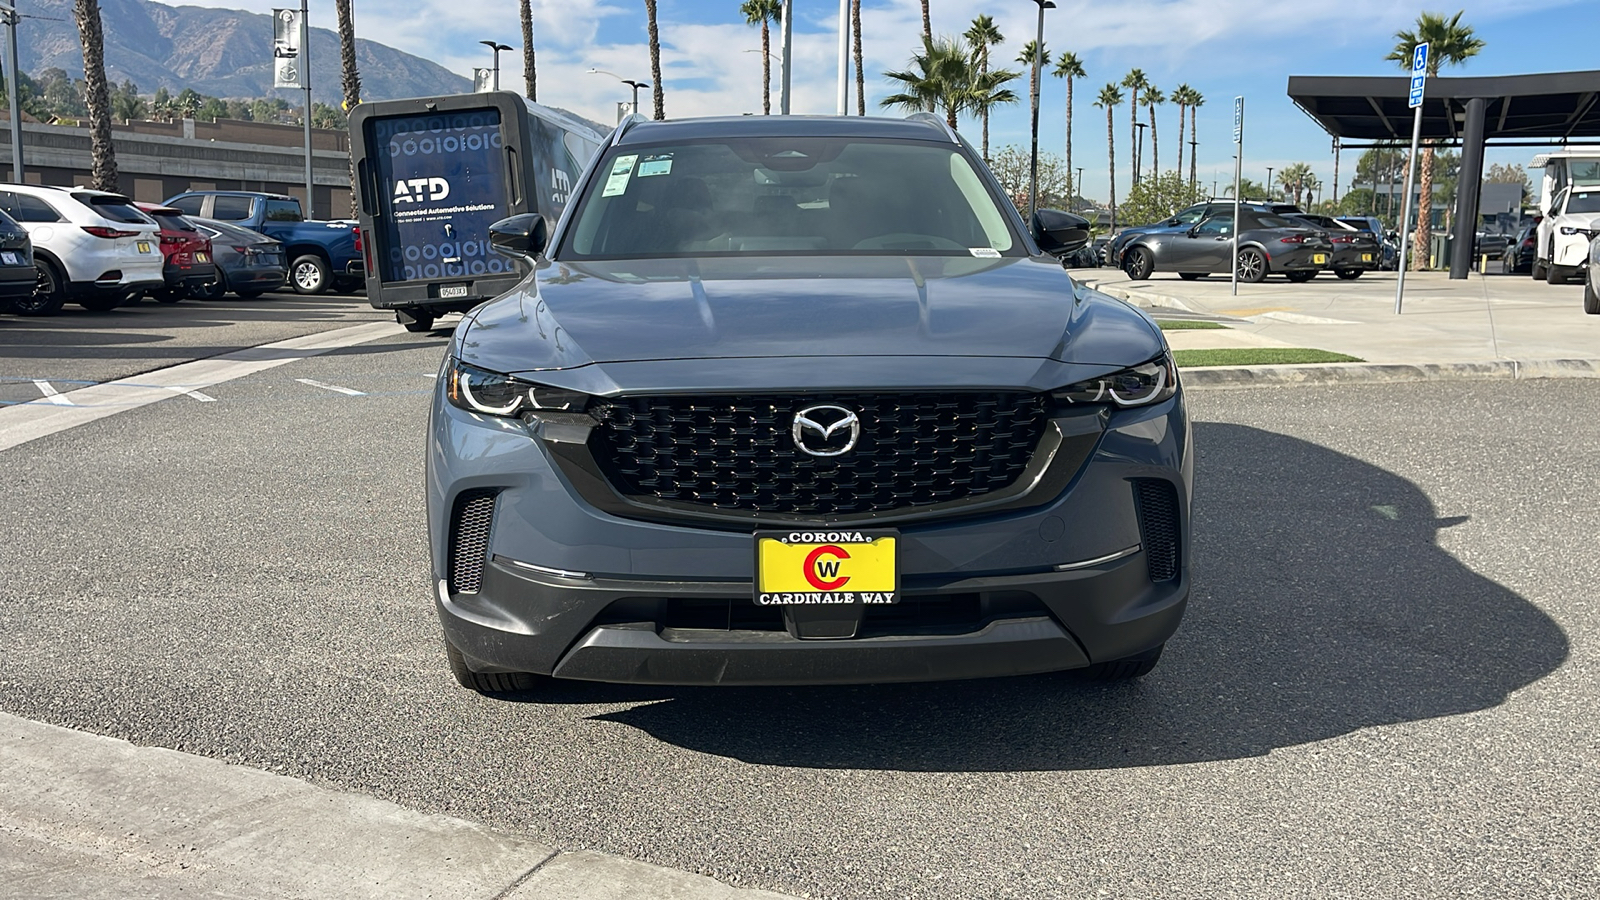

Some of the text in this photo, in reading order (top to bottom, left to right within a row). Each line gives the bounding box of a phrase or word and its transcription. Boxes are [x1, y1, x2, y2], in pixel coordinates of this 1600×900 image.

[392, 177, 450, 204] ATD
[393, 203, 495, 217] Connected Automotive Solutions
[788, 532, 865, 543] CORONA
[759, 592, 895, 605] CARDINALE WAY
